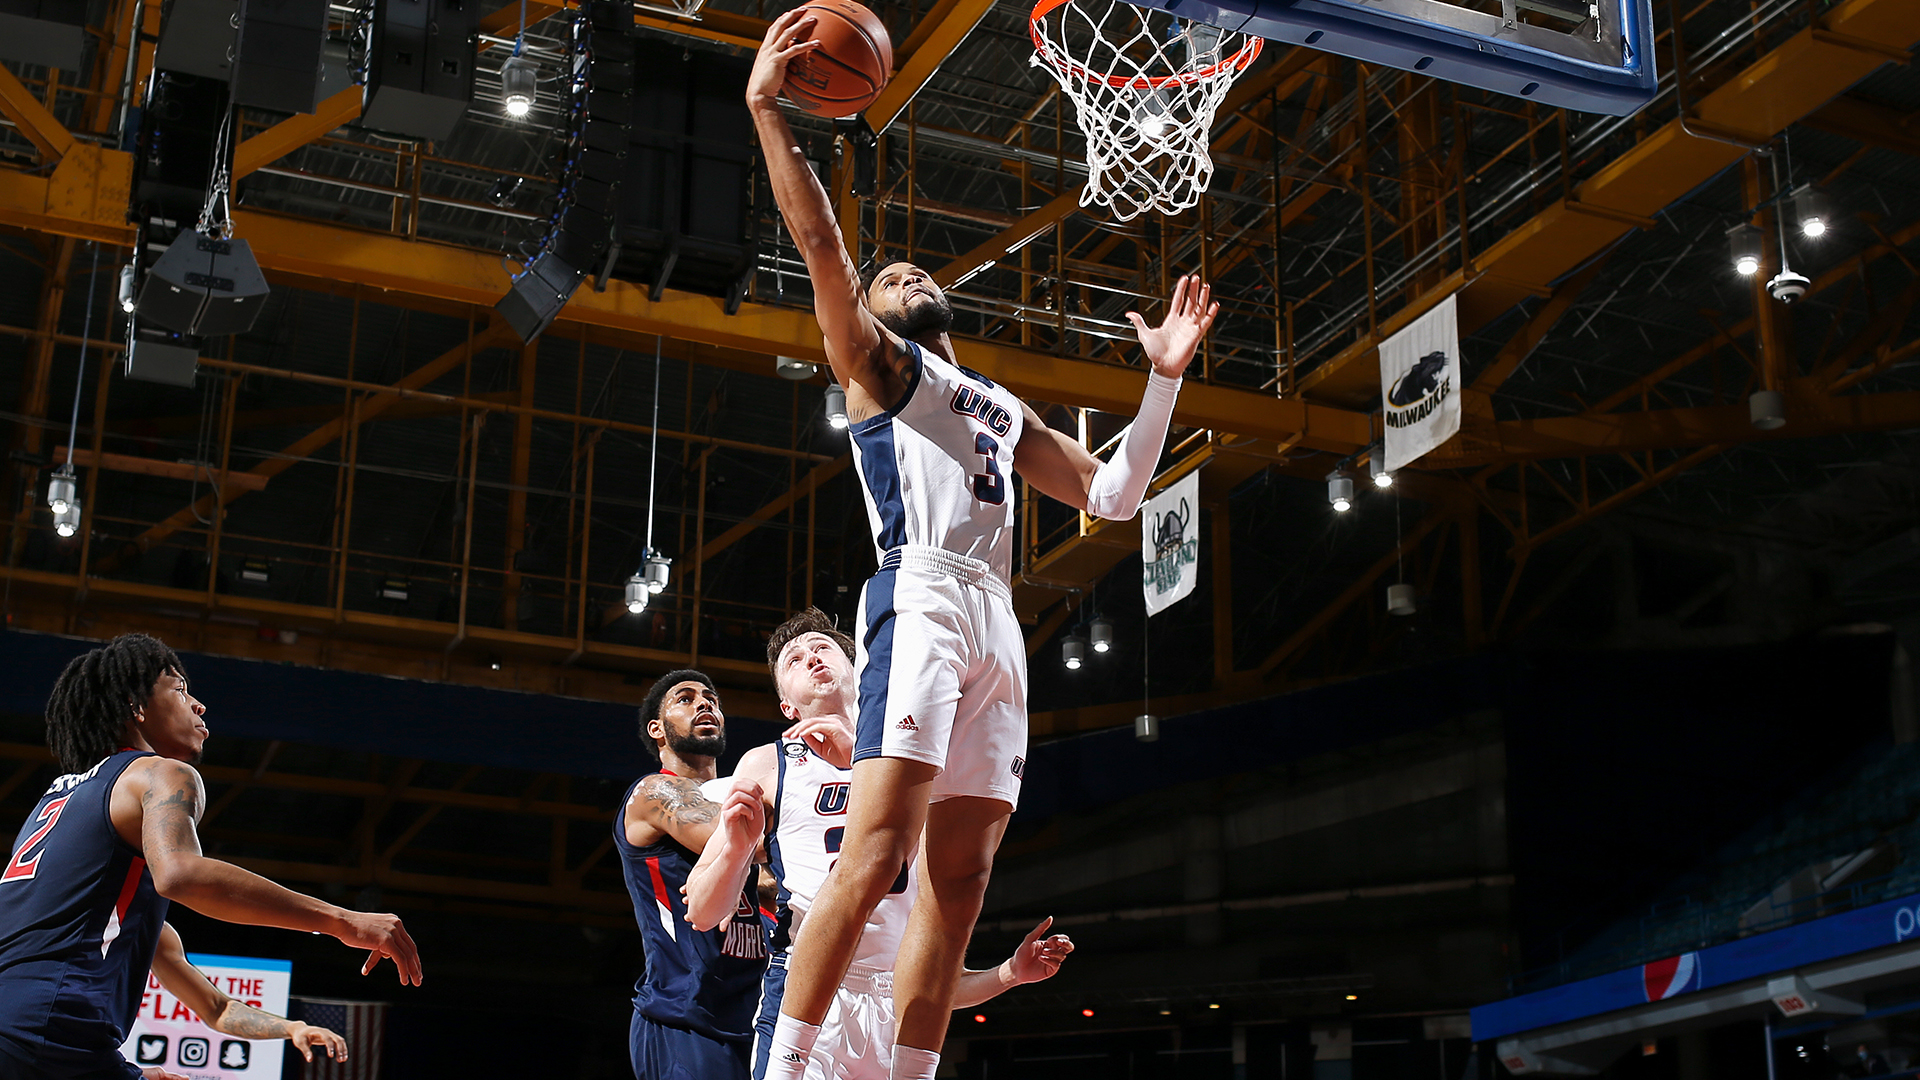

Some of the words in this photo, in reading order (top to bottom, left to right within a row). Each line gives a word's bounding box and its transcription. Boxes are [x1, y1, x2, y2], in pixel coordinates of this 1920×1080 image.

[949, 383, 1013, 438] UIC
[1386, 374, 1451, 429] MILWAUKEE
[972, 431, 1005, 506] 3
[0, 790, 75, 884] 2
[226, 976, 264, 997] THE
